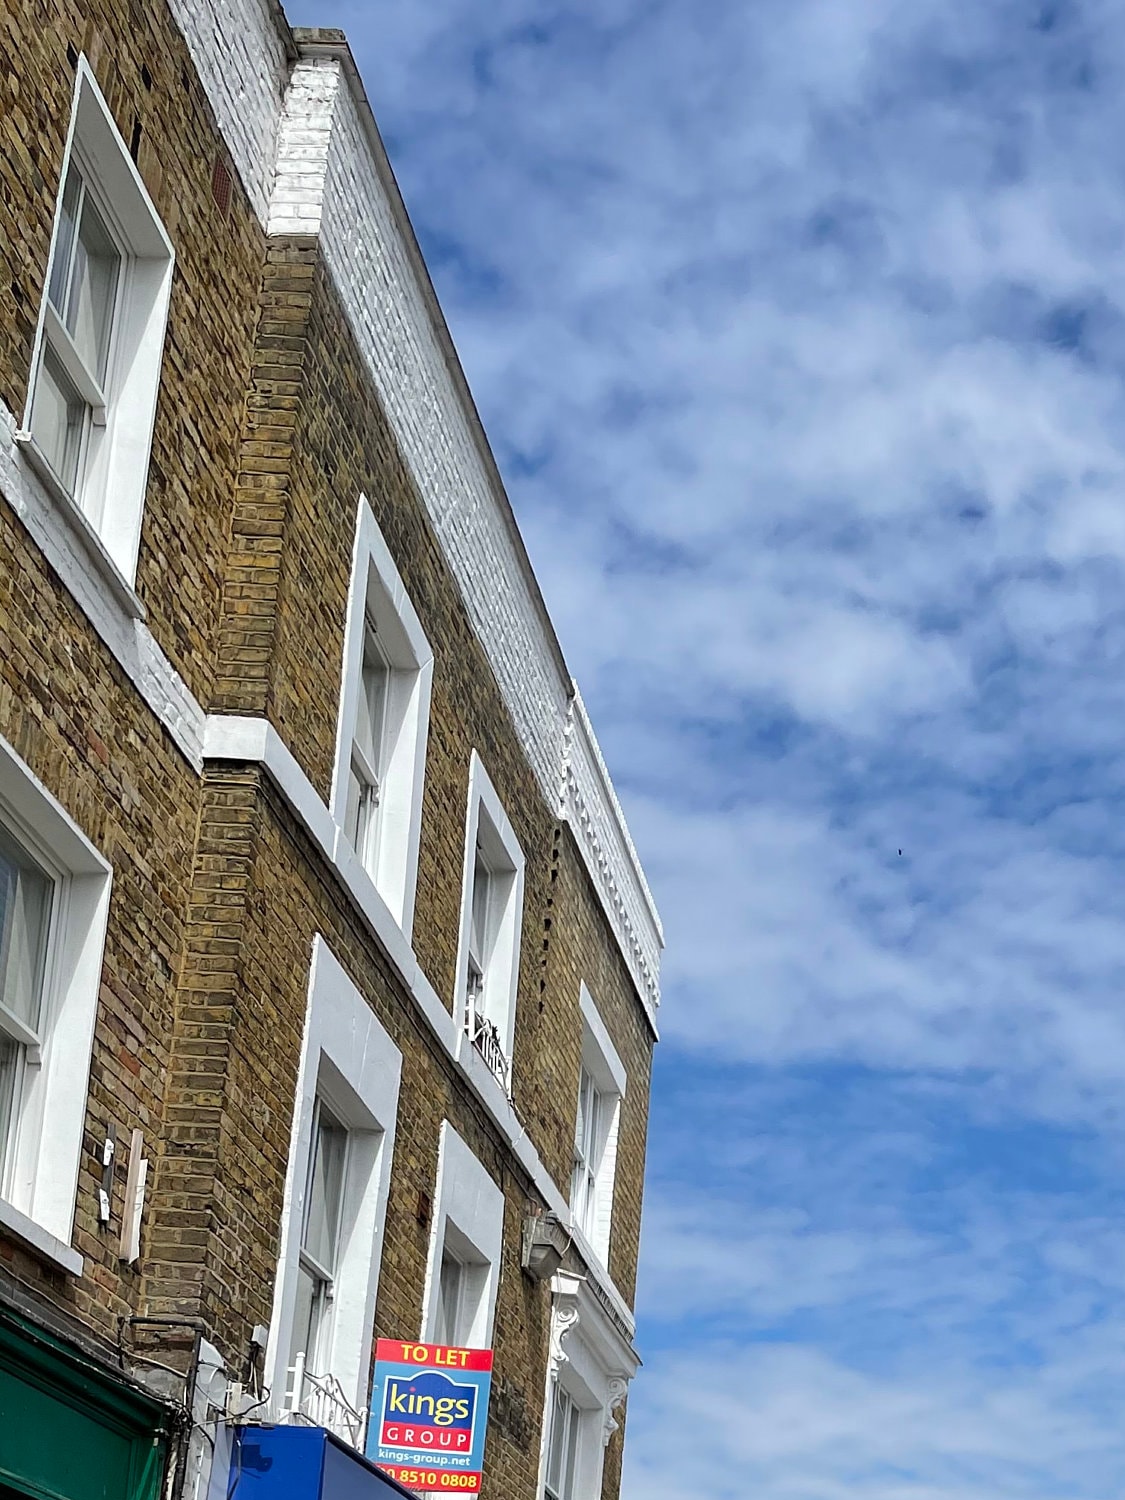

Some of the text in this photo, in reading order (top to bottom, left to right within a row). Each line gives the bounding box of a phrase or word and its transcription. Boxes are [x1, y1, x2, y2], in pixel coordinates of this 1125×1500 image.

[401, 1344, 471, 1367] TO LET
[389, 1383, 469, 1426] kings
[386, 1427, 467, 1447] GROUP
[378, 1448, 471, 1467] kings-group.net
[399, 1469, 437, 1485] 8510
[440, 1473, 477, 1488] 0808
